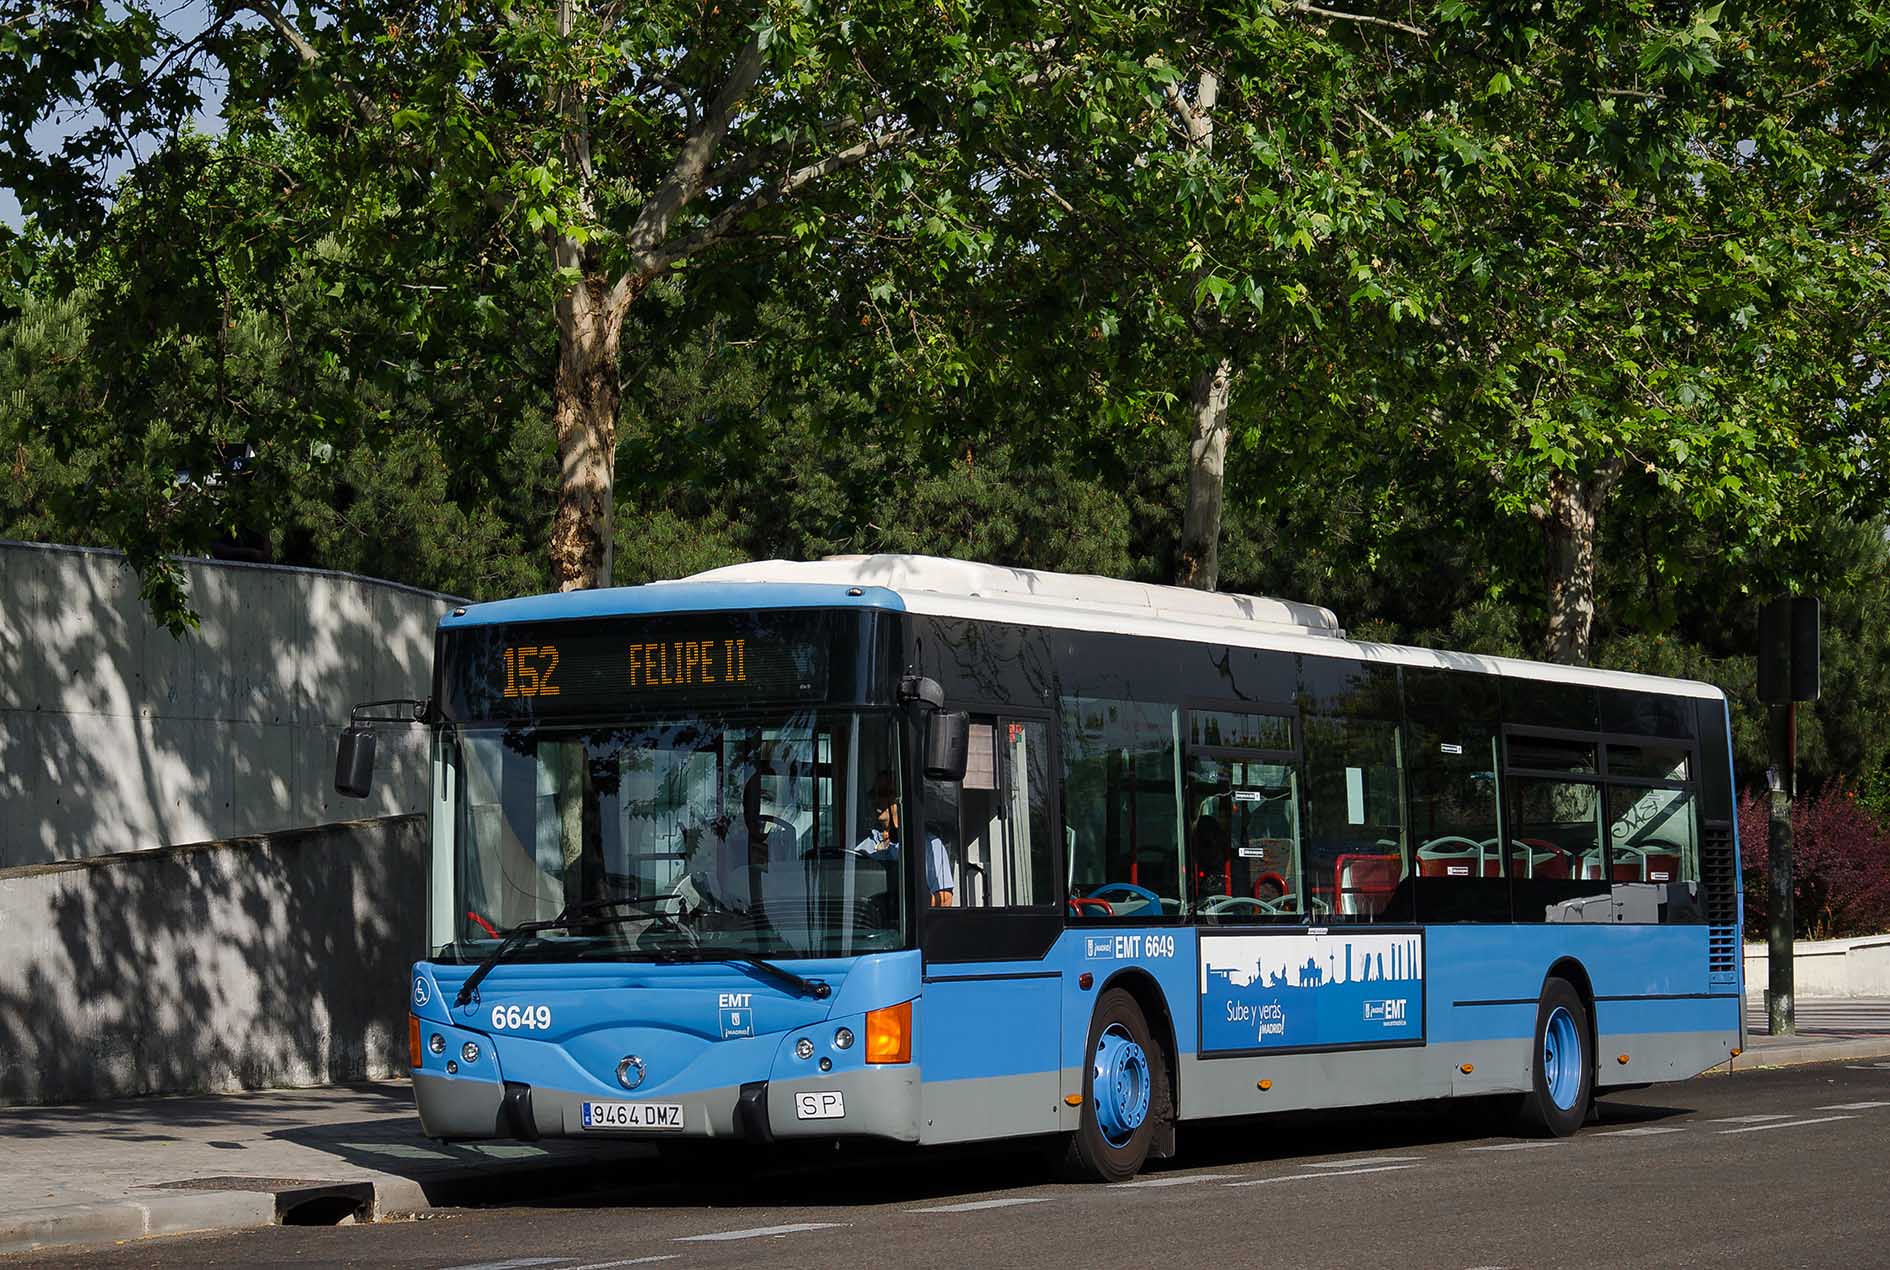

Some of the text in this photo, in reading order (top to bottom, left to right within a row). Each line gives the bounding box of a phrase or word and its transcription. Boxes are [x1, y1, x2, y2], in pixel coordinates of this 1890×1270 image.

[503, 645, 560, 697] 152
[630, 641, 715, 686] FELIPE
[1115, 936, 1141, 958] EMT
[1145, 936, 1174, 957] 6649
[719, 993, 752, 1007] EMT
[1385, 999, 1406, 1020] EMT
[491, 1005, 551, 1029] 6649
[1226, 998, 1281, 1027] Sube y verás
[594, 1105, 680, 1126] 9464 DMZ
